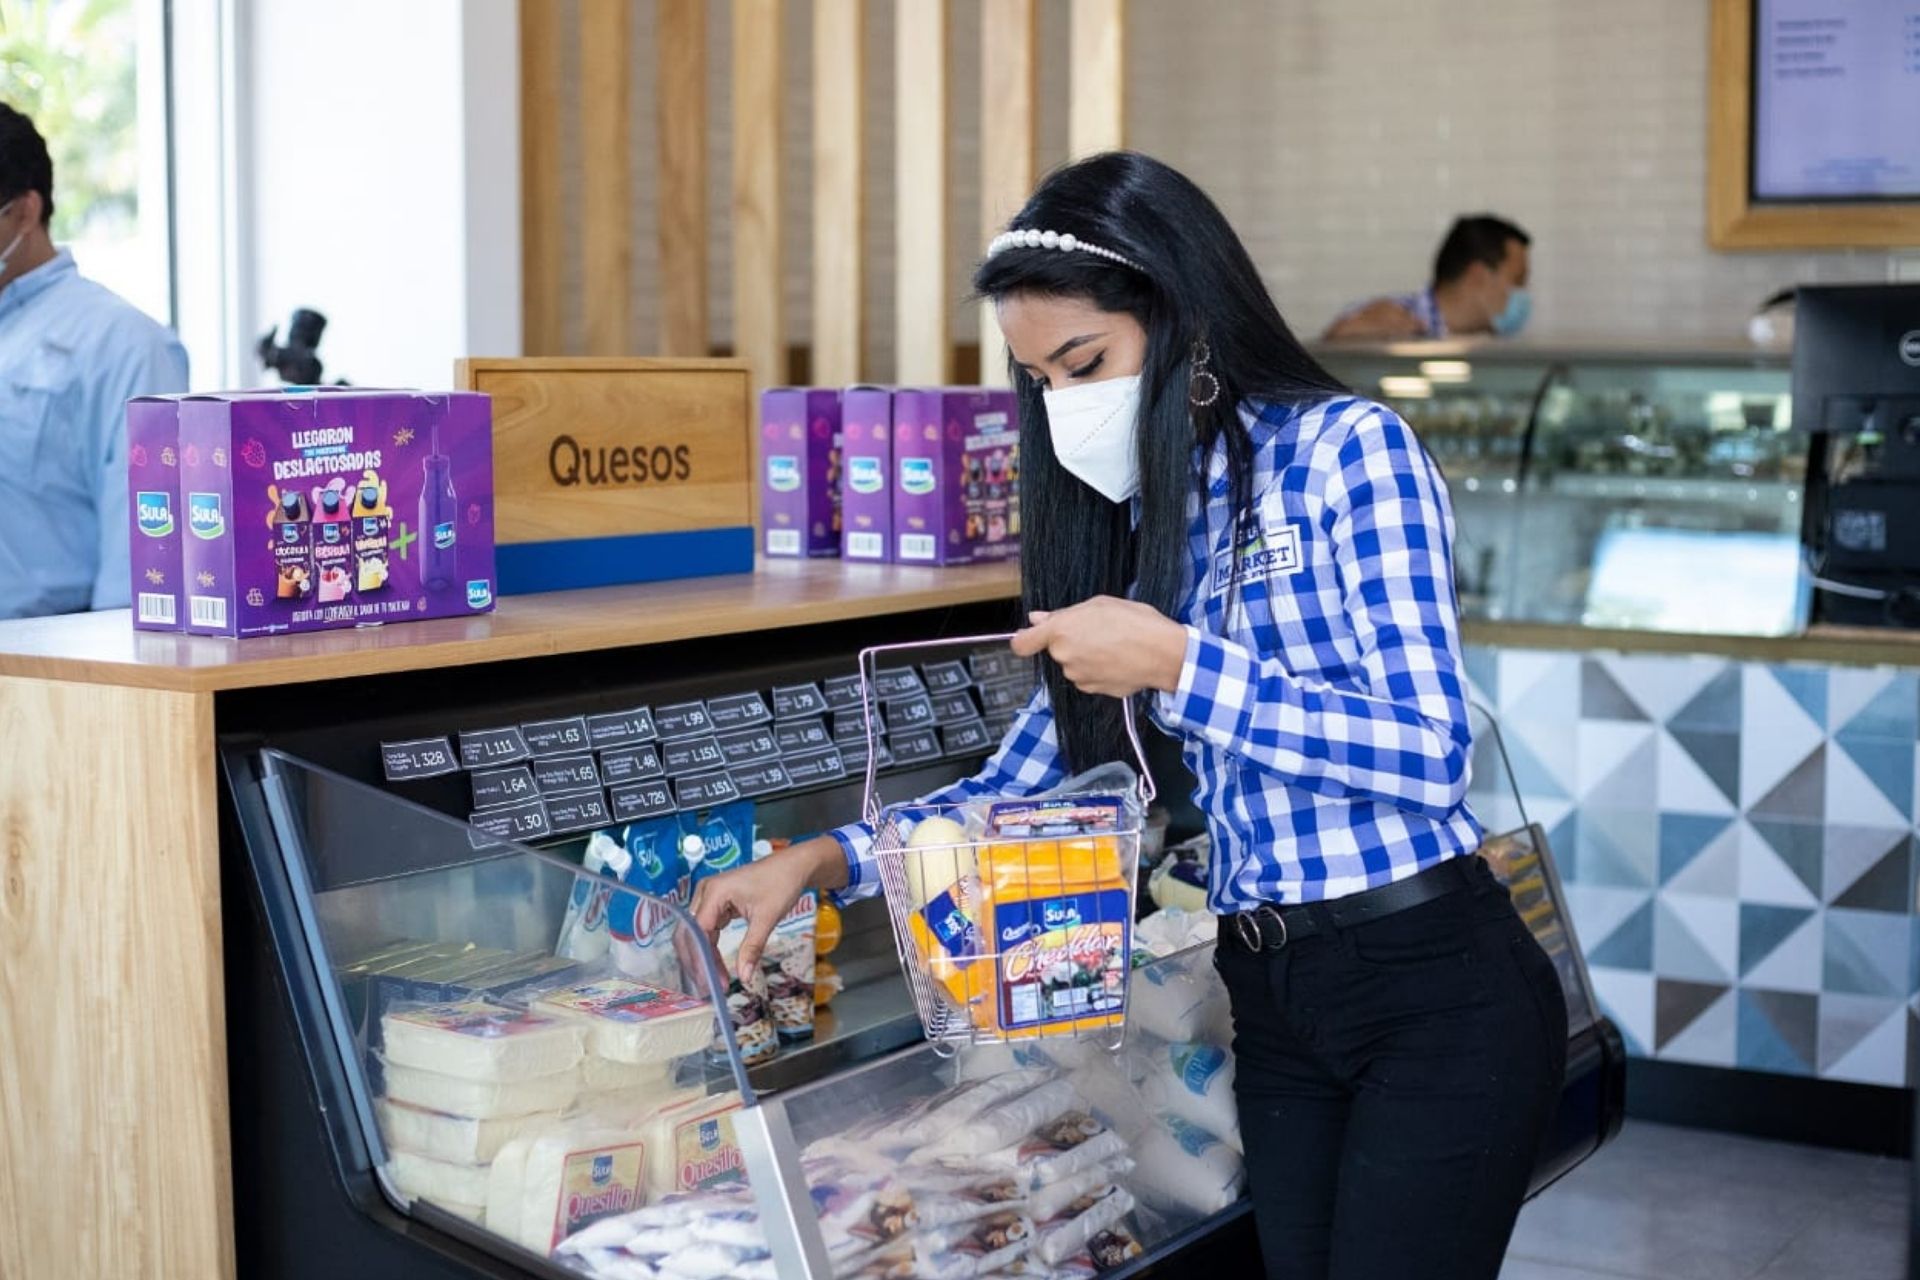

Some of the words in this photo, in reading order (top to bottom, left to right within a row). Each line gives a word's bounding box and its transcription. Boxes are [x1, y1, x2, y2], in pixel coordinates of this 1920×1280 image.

[291, 426, 355, 449] LLEGARON
[273, 450, 383, 480] DESLACTOSADAS
[549, 434, 692, 486] Quesos
[139, 504, 168, 522] SULA
[191, 505, 219, 523] SULA
[624, 718, 649, 735] L14
[484, 739, 516, 756] L111
[411, 751, 446, 768] L328
[501, 777, 527, 794] L64
[578, 803, 601, 818] L50
[514, 814, 542, 832] L30
[704, 832, 733, 855] SULA
[681, 1144, 743, 1189] Quesillo
[567, 1182, 632, 1223] Quesillo
